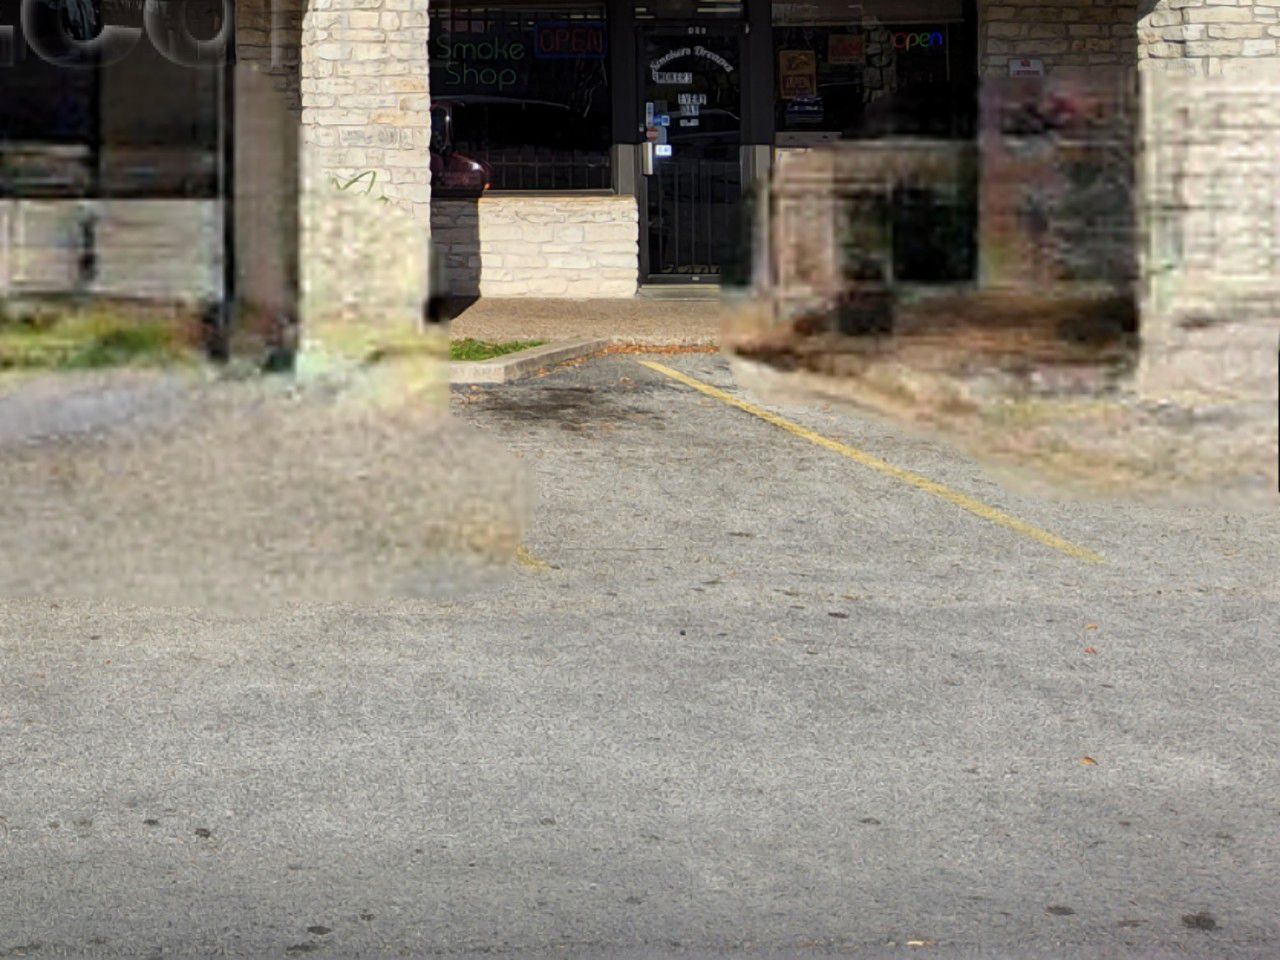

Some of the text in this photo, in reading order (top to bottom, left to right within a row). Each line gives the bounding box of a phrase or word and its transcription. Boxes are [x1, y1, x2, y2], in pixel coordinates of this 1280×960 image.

[435, 35, 525, 61] Smoke
[540, 29, 603, 52] OPEN
[893, 32, 943, 51] open
[445, 62, 518, 91] Shop
